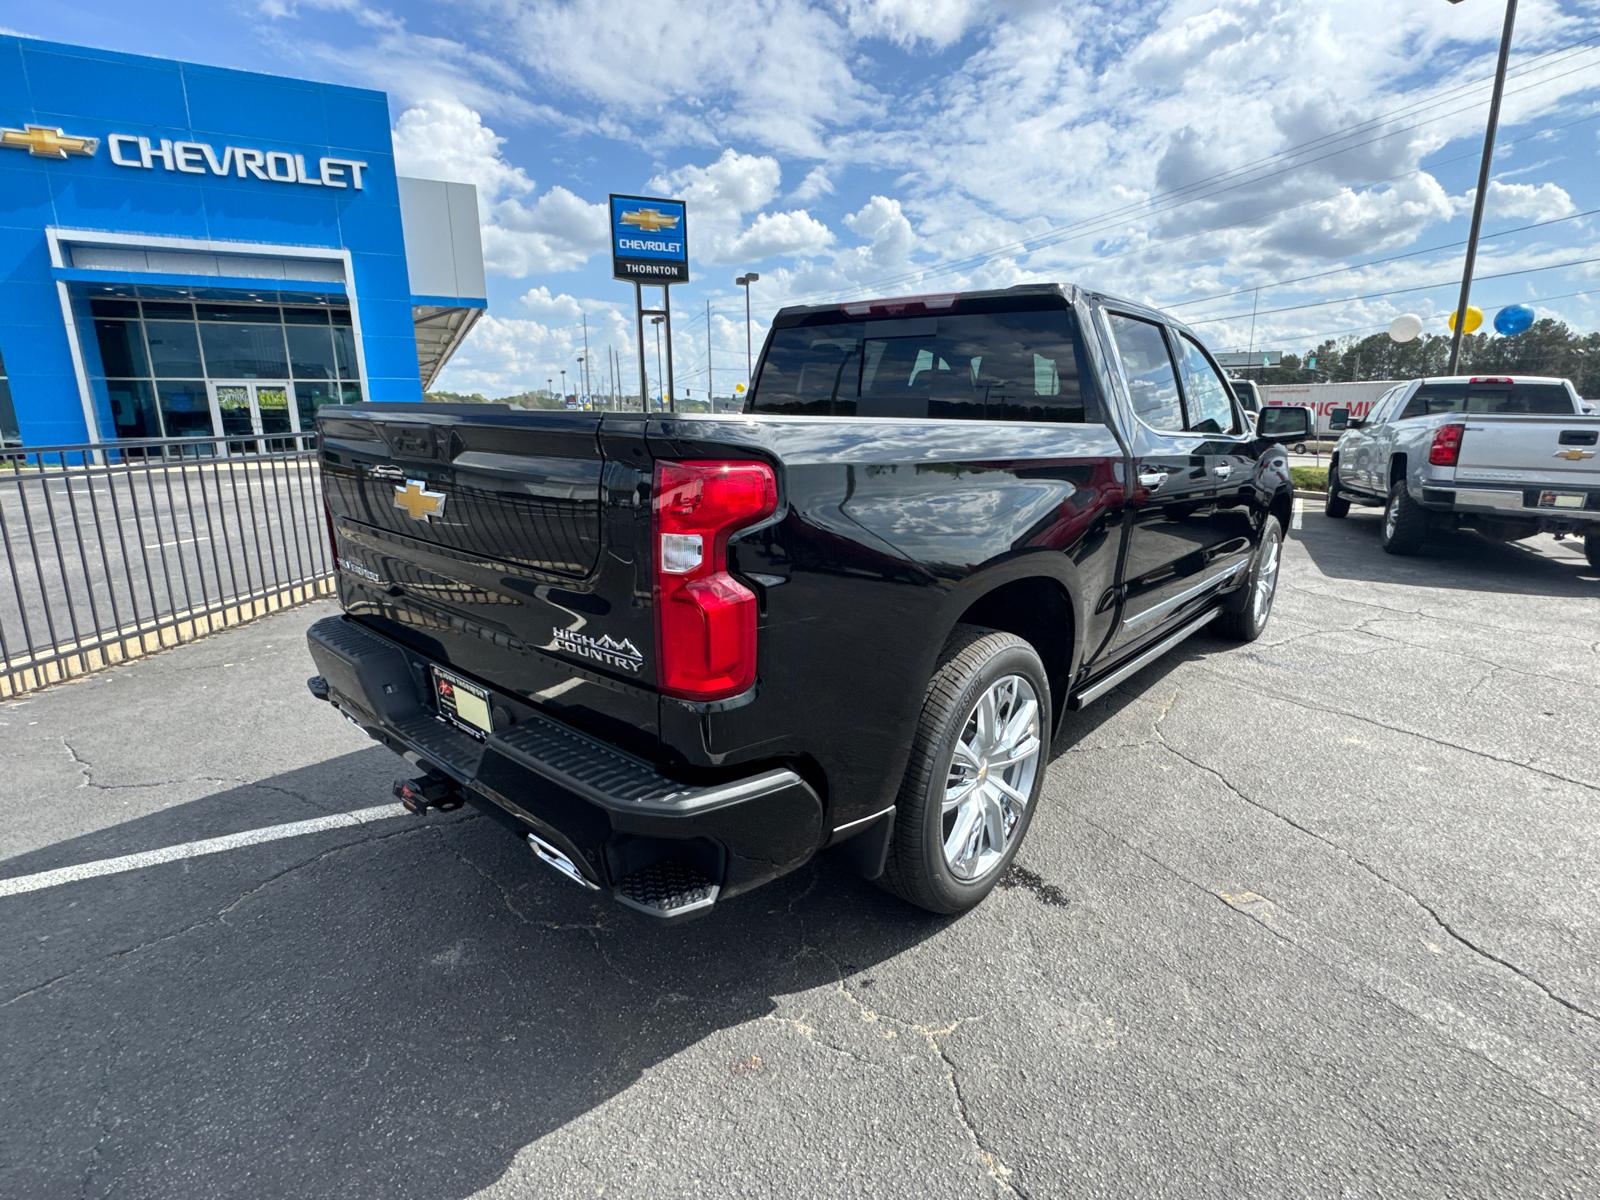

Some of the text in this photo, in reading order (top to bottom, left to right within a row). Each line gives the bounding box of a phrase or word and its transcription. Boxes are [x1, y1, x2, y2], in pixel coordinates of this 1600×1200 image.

[108, 133, 368, 190] CHEVROLET
[619, 239, 681, 253] CHEVROLET
[626, 264, 678, 275] THORNTON
[553, 626, 598, 648] HIGH
[555, 638, 644, 672] COUNTRY
